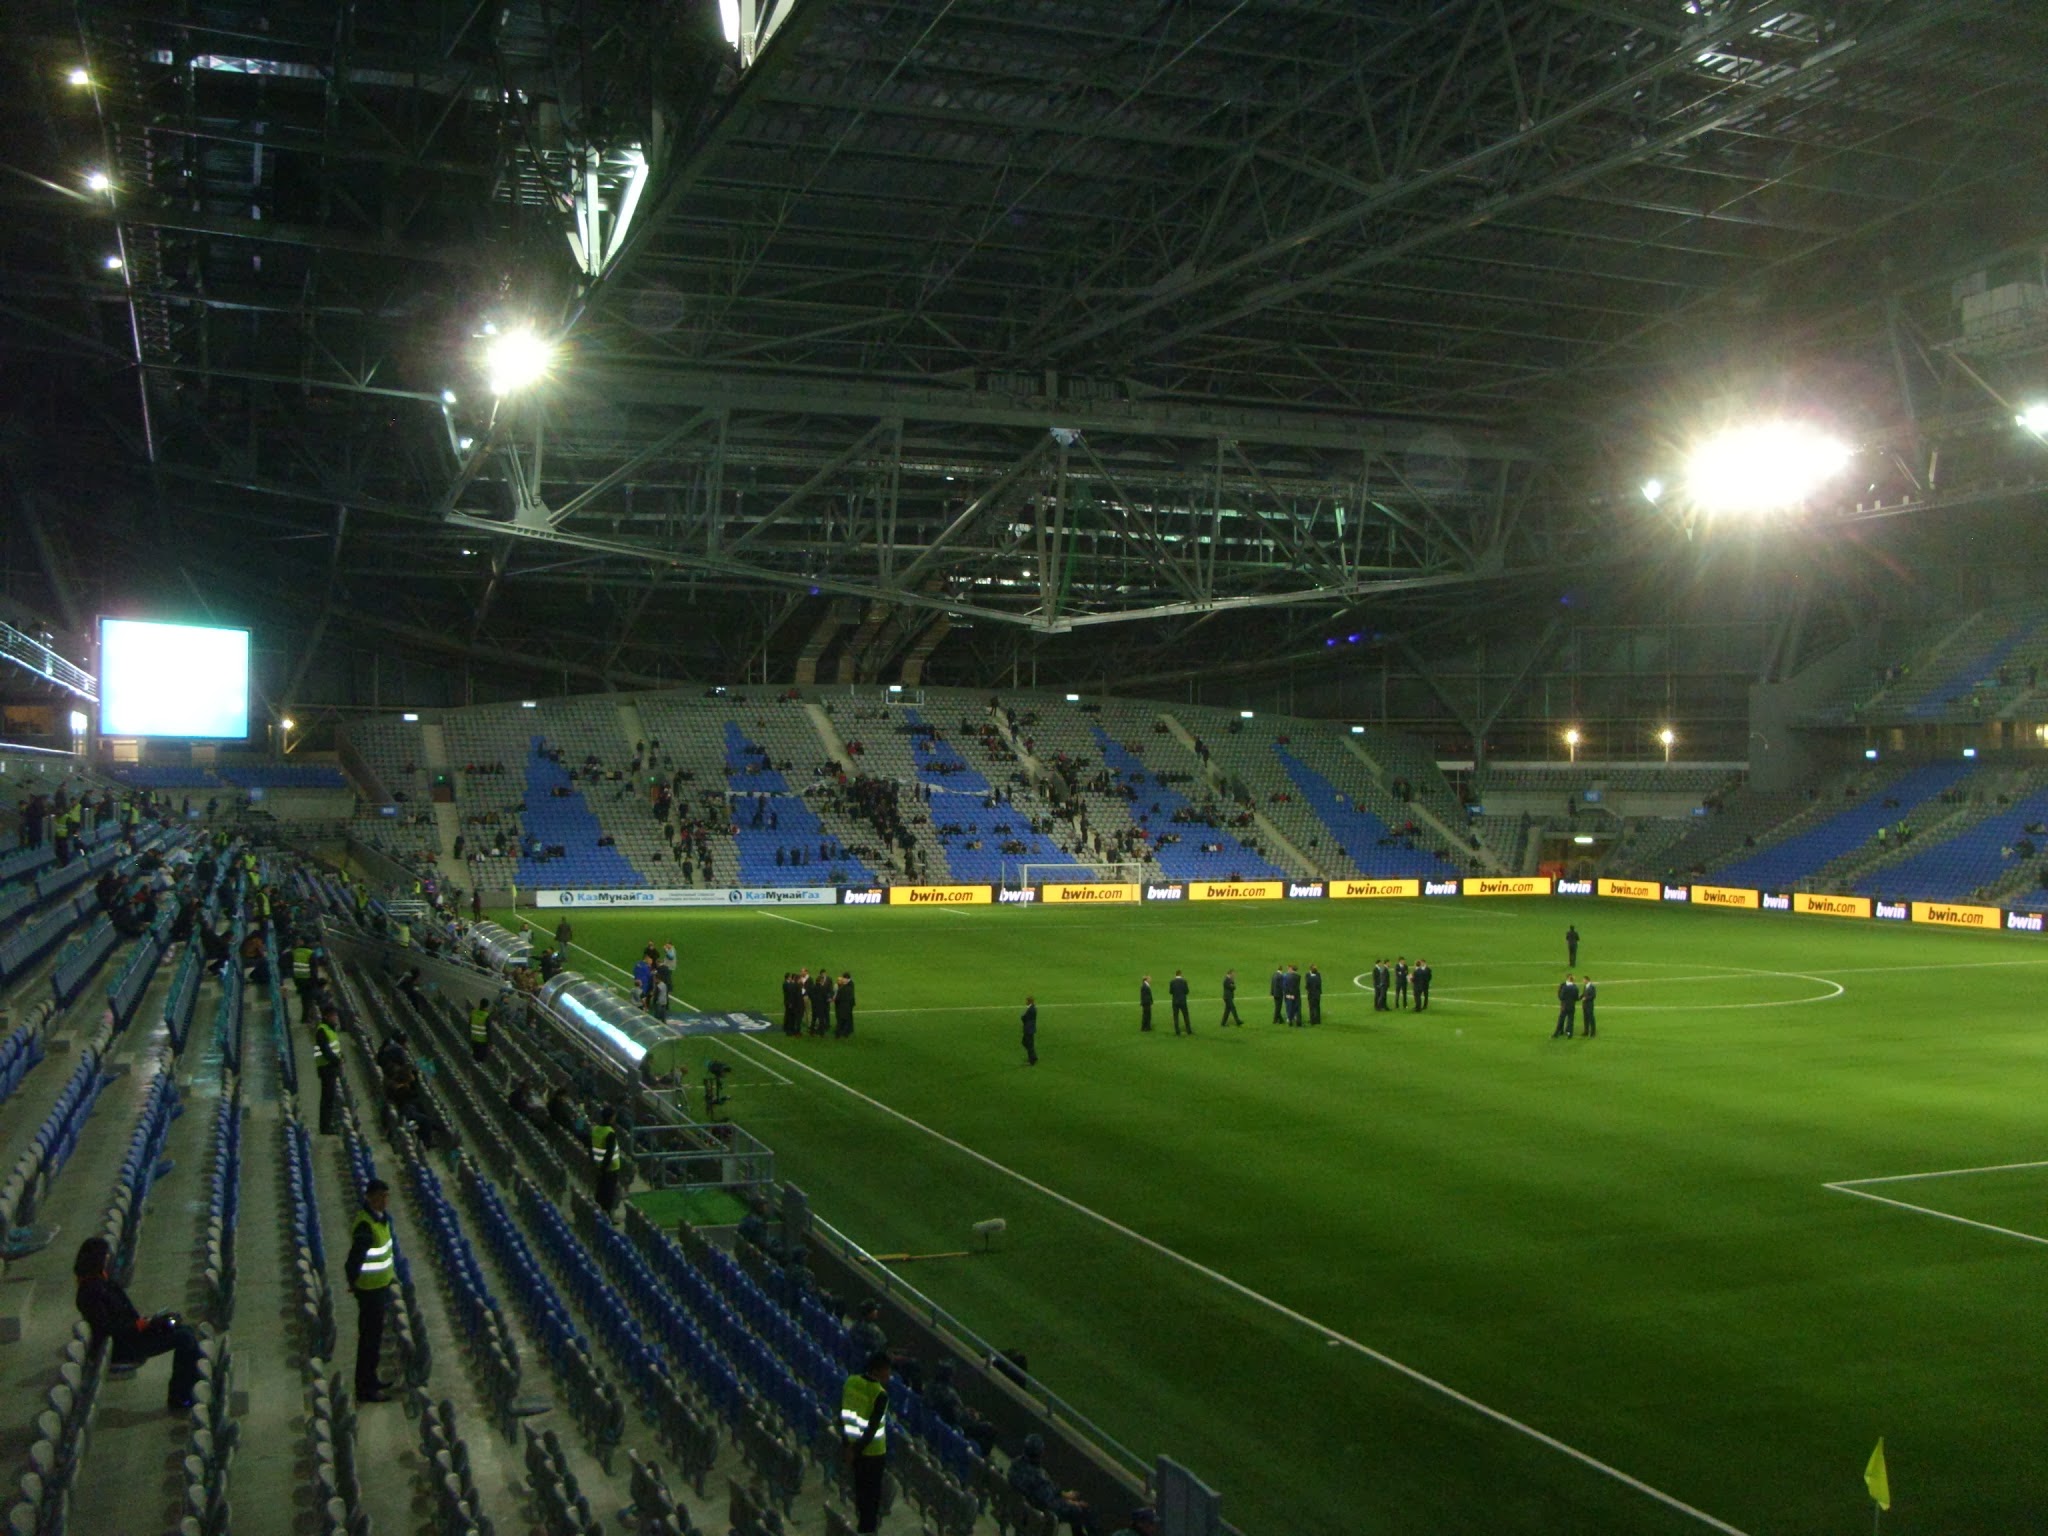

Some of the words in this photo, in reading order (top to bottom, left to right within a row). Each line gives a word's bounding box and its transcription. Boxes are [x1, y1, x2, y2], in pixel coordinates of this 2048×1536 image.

[1061, 887, 1123, 900] bwin.com
[1147, 886, 1181, 899] bwin
[1207, 885, 1266, 898] bwin.com
[1289, 884, 1323, 897] bwin
[1346, 883, 1403, 895] bwin.com
[1425, 881, 1457, 895] bwin
[1479, 881, 1534, 893] bwin.com
[1557, 879, 1591, 894] bwin
[1610, 882, 1649, 897] bwin.com
[1664, 886, 1687, 900] bwin
[844, 890, 881, 904] bwin
[909, 889, 973, 902] bwin.com
[999, 888, 1034, 901] bwin
[1703, 890, 1746, 905] bwin.com
[1763, 893, 1788, 909] bwin
[1808, 898, 1856, 914] bwin.com
[1876, 902, 1906, 919] bwin
[1928, 907, 1984, 925] bwin.com
[2007, 912, 2043, 931] bwin
